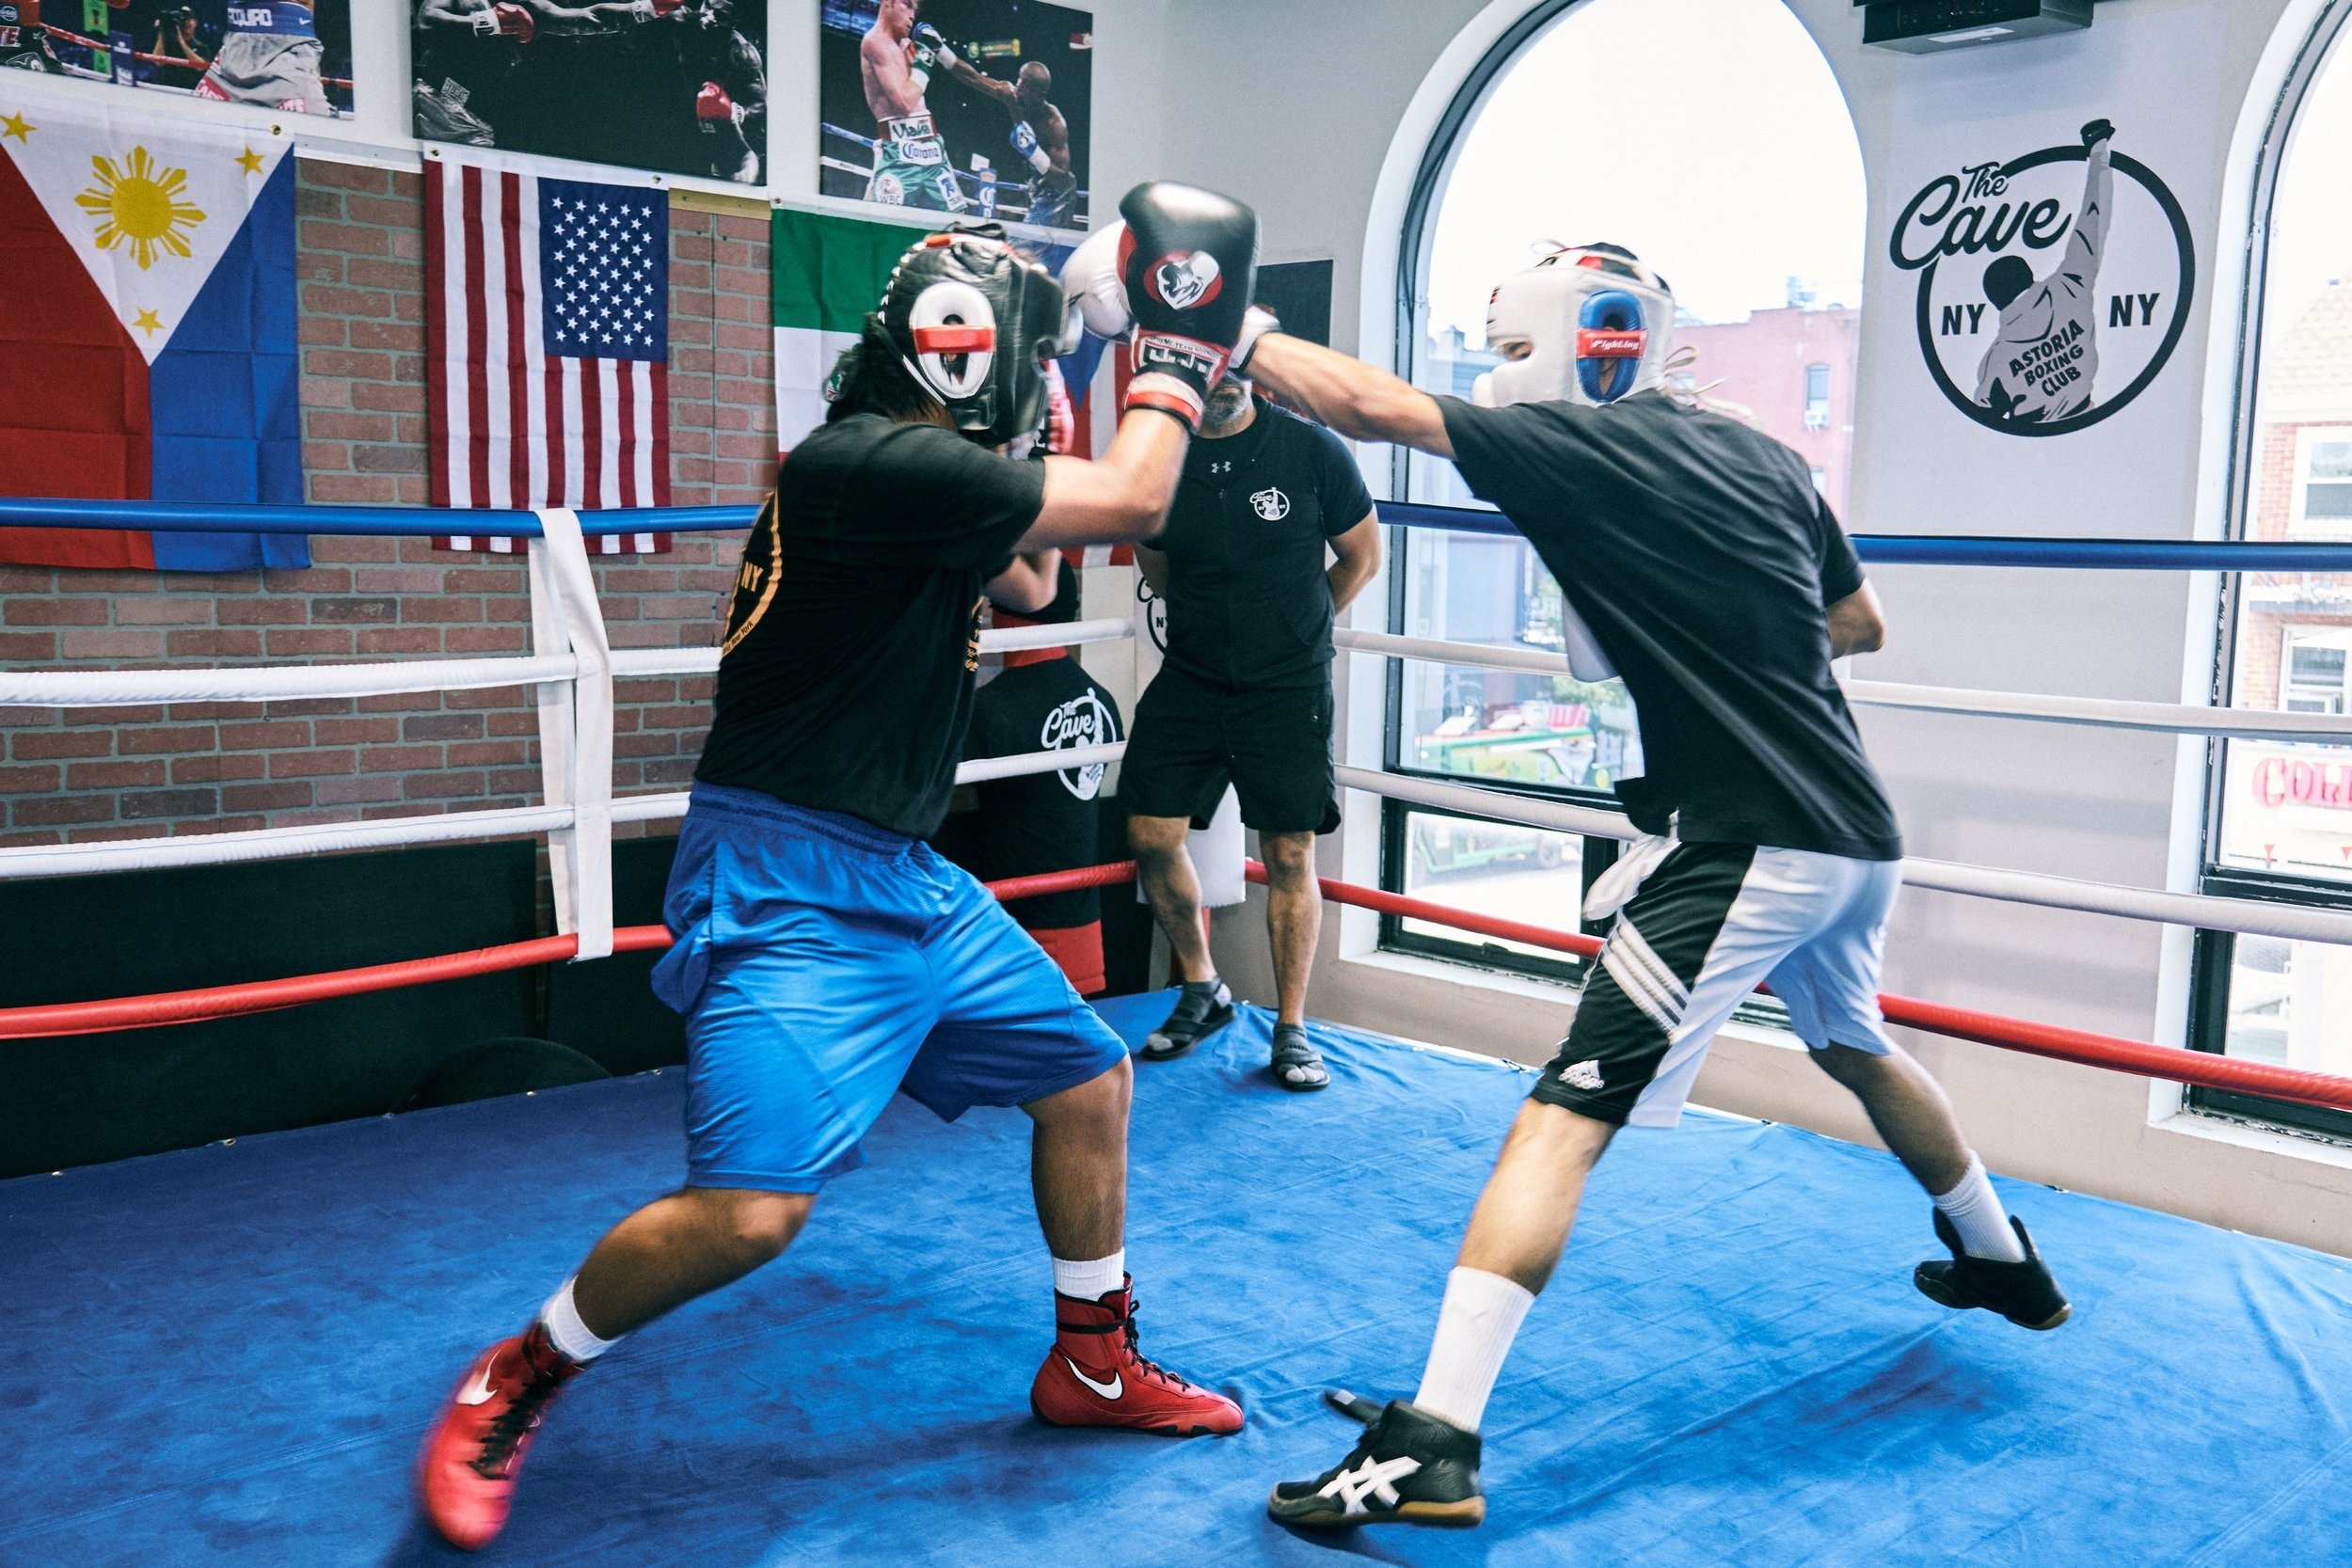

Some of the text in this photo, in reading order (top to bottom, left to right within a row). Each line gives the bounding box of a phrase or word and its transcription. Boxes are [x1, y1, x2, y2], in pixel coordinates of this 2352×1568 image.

[1962, 161, 2009, 203] The
[1889, 175, 2073, 271] Cave
[1941, 303, 1987, 336] NY
[2108, 292, 2161, 328] NY
[2009, 318, 2085, 378] ASTORIA
[2024, 343, 2085, 388] BOXING
[2042, 365, 2082, 397] CLUB
[741, 562, 764, 593] NY
[1156, 617, 1167, 628] N
[1041, 707, 1095, 749] Cave
